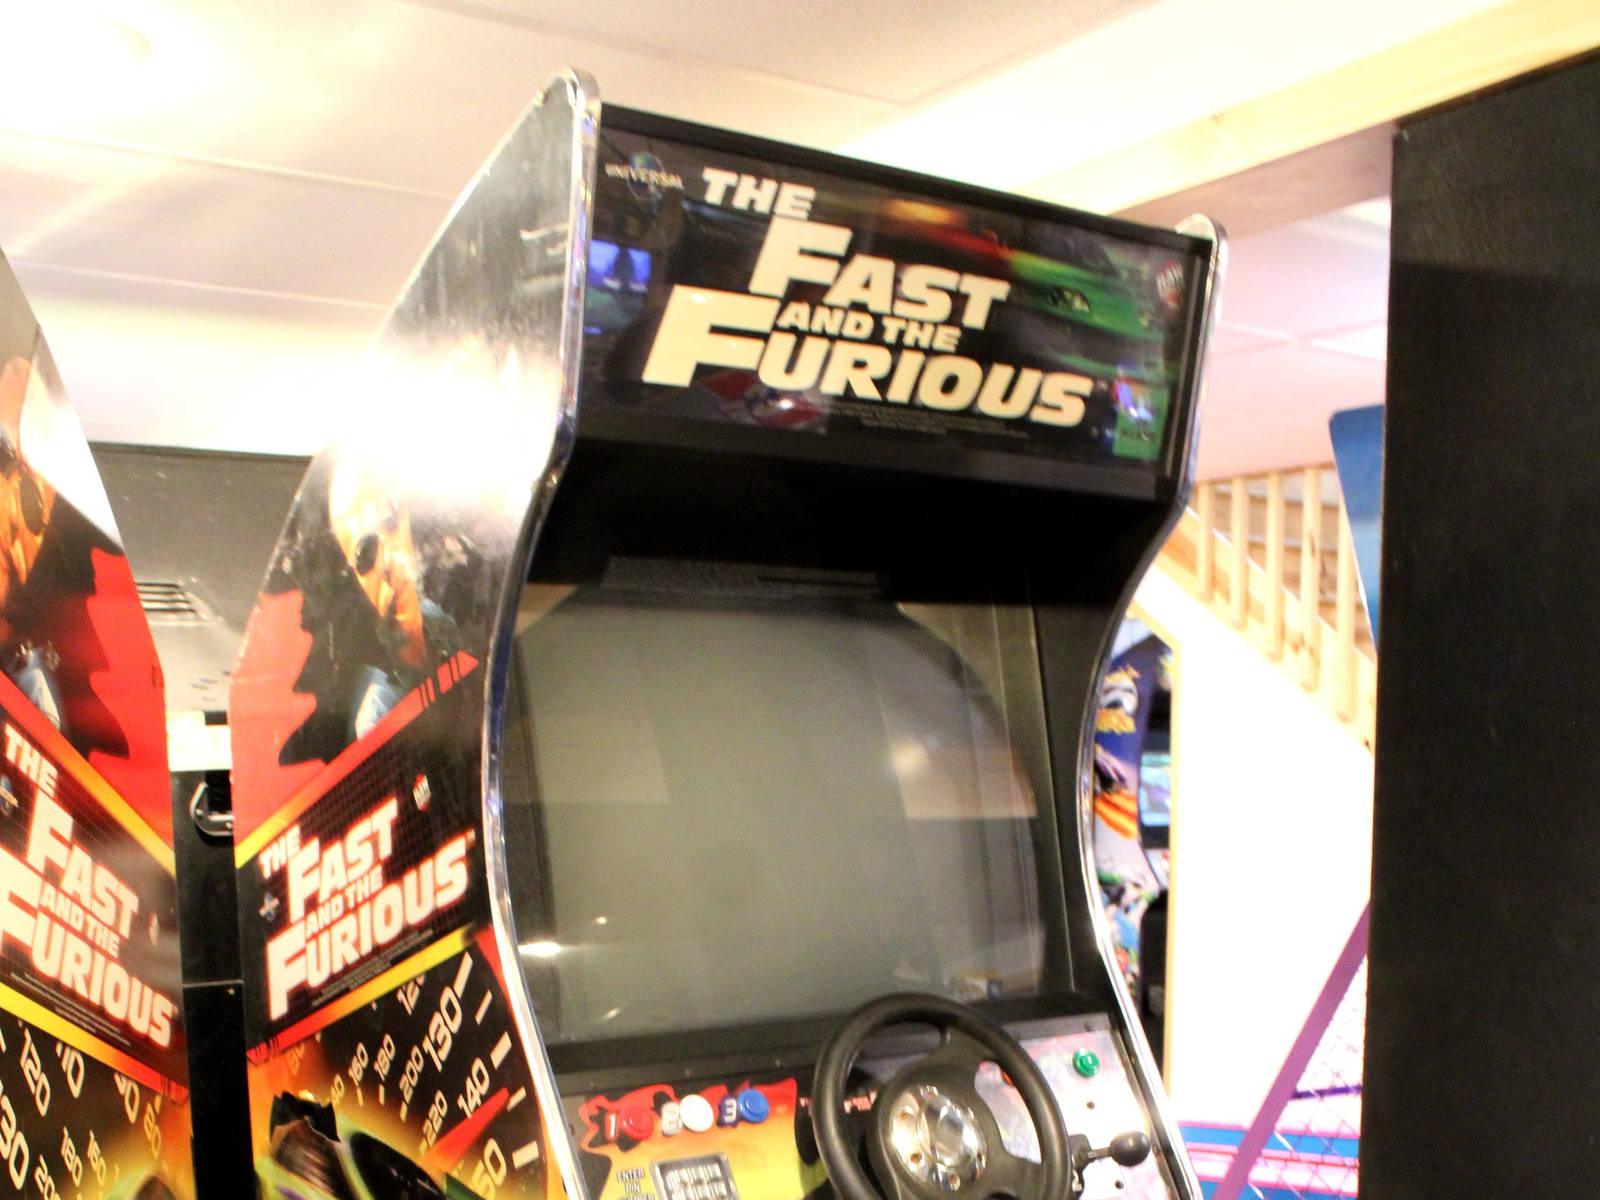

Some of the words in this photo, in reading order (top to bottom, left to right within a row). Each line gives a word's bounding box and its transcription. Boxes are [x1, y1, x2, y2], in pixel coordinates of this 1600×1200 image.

[700, 167, 816, 220] THE
[748, 215, 1011, 331] FAST
[641, 284, 1094, 428] FURIOUS
[777, 301, 875, 338] AND
[881, 317, 961, 352] THE
[4, 723, 58, 798] THE
[27, 787, 140, 940] FAST
[259, 824, 300, 880] THE
[287, 796, 398, 925] FAST
[40, 887, 84, 932] AND
[85, 917, 121, 959] THE
[266, 836, 469, 1022] FURIOUS
[306, 897, 345, 940] AND
[345, 864, 383, 909] THE
[0, 848, 173, 1049] FURIOUS
[373, 1033, 396, 1081] 180
[422, 985, 463, 1073] 130
[19, 1027, 51, 1117] 120
[348, 1042, 369, 1087] 160
[399, 1045, 424, 1101] 200
[457, 1057, 491, 1119] 140
[143, 1102, 162, 1159] 80
[422, 1090, 448, 1150] 220
[609, 1112, 617, 1139] 1
[724, 1098, 737, 1123] 3
[61, 1126, 83, 1187] 180
[616, 1168, 645, 1184] ENTER
